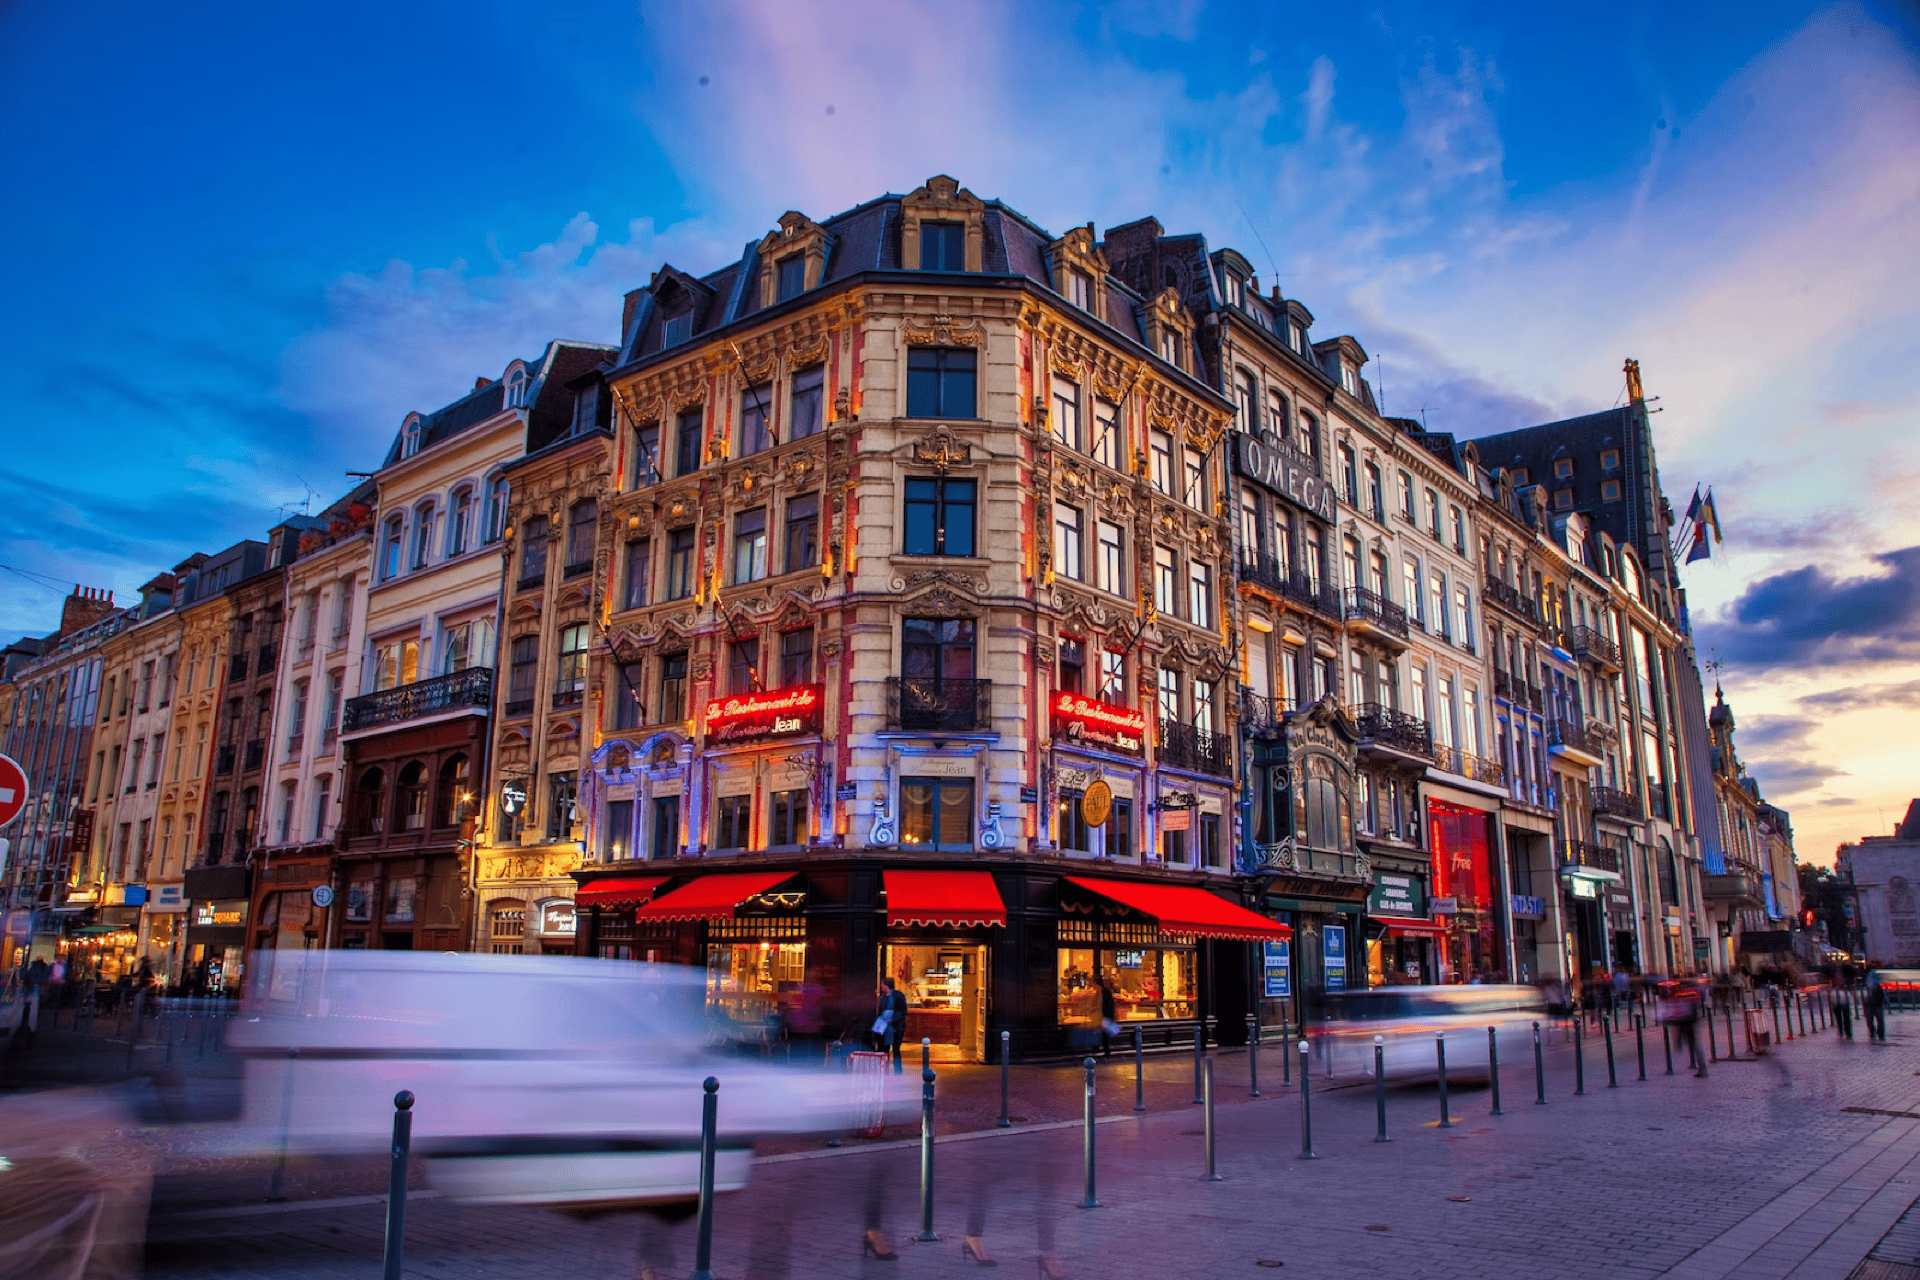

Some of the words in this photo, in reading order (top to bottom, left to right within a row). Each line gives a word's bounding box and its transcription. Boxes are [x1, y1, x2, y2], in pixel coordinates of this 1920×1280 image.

[1247, 440, 1332, 519] OMEGA
[705, 702, 723, 720] Le
[723, 692, 798, 717] Restaurant
[796, 689, 816, 706] de
[1056, 695, 1076, 713] Le
[1074, 701, 1134, 727] Restaurant
[1131, 714, 1146, 730] de
[771, 716, 802, 734] Jean
[1115, 732, 1139, 751] Jean
[943, 764, 967, 775] Jean
[1086, 796, 1109, 811] PAUL
[1452, 852, 1472, 873] free
[213, 911, 241, 924] SQUARE
